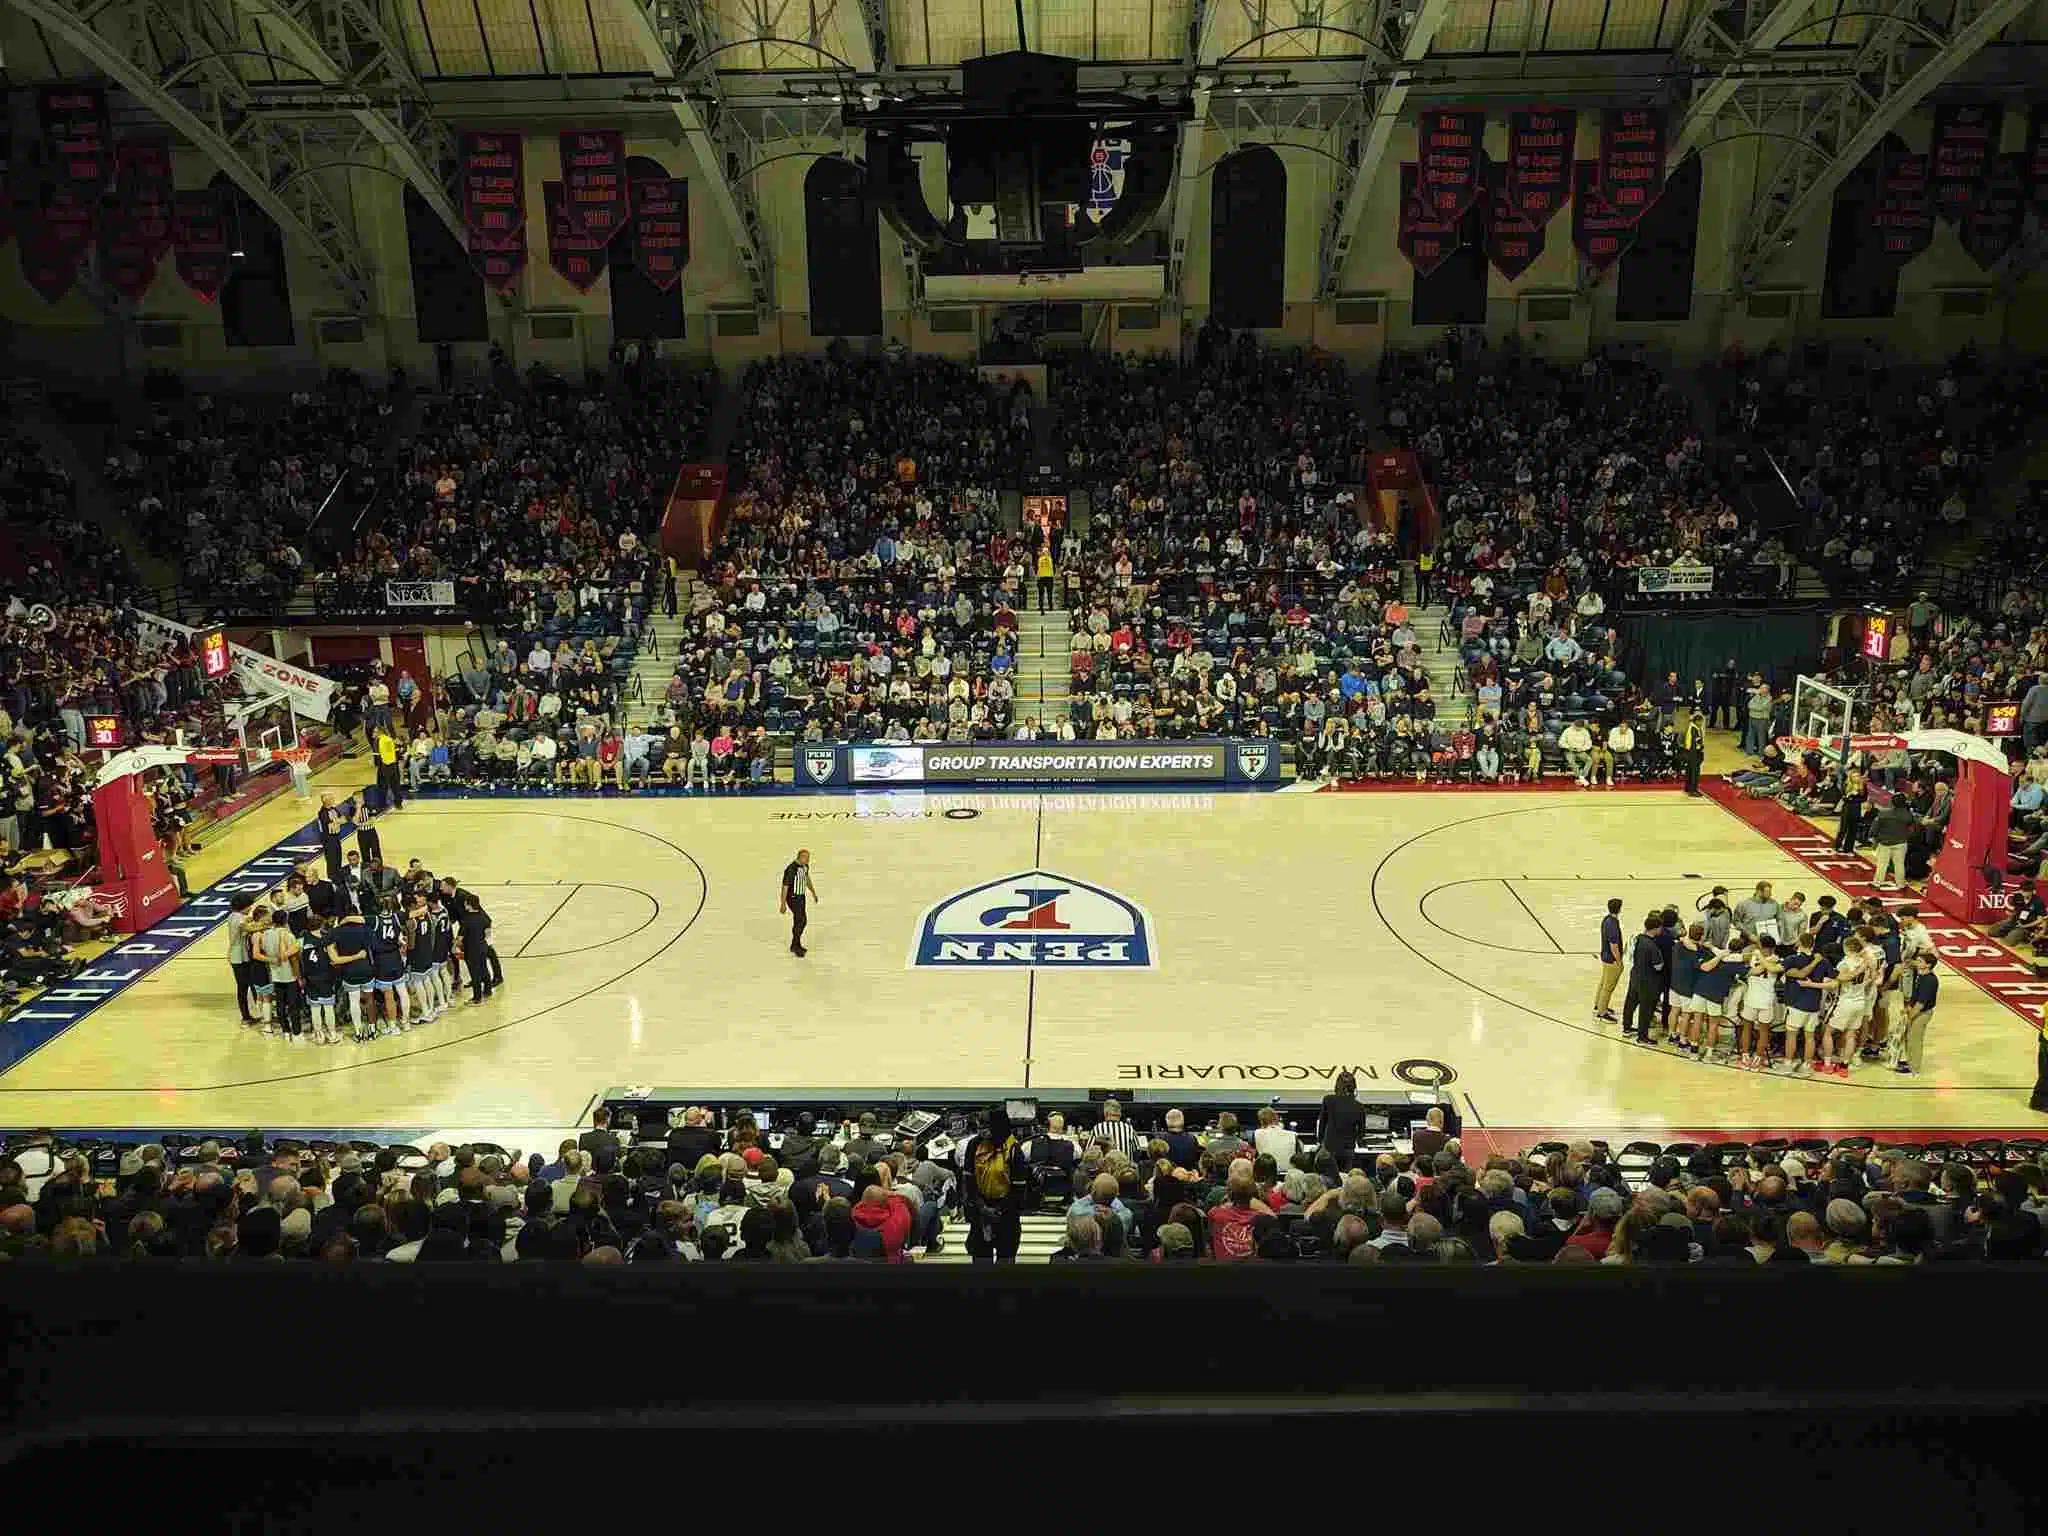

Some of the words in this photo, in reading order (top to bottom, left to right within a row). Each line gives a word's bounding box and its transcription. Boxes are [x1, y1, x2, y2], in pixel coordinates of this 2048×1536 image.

[263, 664, 320, 693] ZONE
[1991, 717, 2009, 732] 30
[95, 730, 113, 744] 30
[929, 756, 985, 770] GROUP
[989, 755, 1138, 770] TRANSPORTATION
[1140, 755, 1214, 769] EXPERTS
[1777, 835, 1873, 872] THE
[979, 889, 1072, 930] P
[1976, 893, 2016, 910] NEC
[7, 968, 143, 1024] THE
[116, 844, 325, 955] PALESTRA
[382, 925, 395, 939] 14
[309, 949, 318, 963] 4
[933, 941, 1130, 961] PENN
[1118, 1064, 1380, 1080] MACQUARIE
